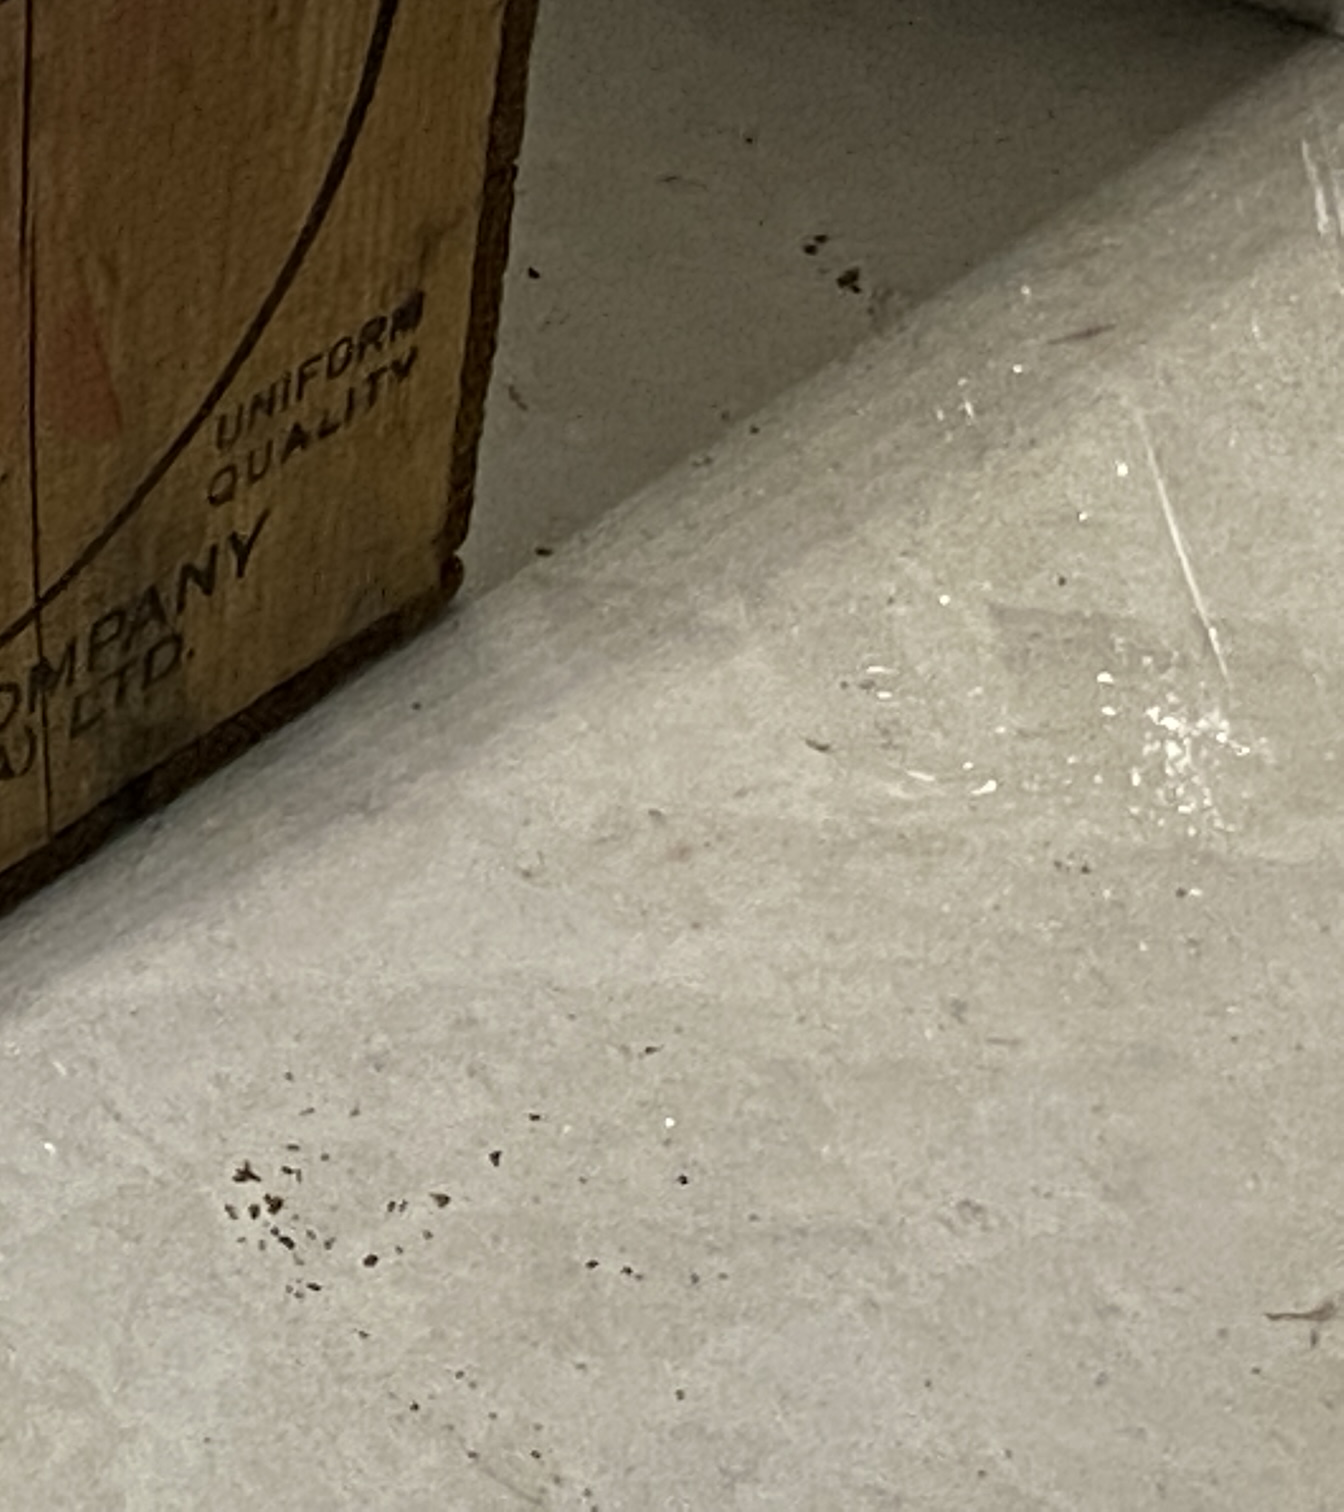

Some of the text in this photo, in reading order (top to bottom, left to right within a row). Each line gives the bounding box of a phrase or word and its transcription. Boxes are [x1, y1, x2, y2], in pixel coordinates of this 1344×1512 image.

[207, 344, 419, 507] QUALITY
[215, 290, 426, 451] UNIFORM
[70, 631, 195, 738] LTD.
